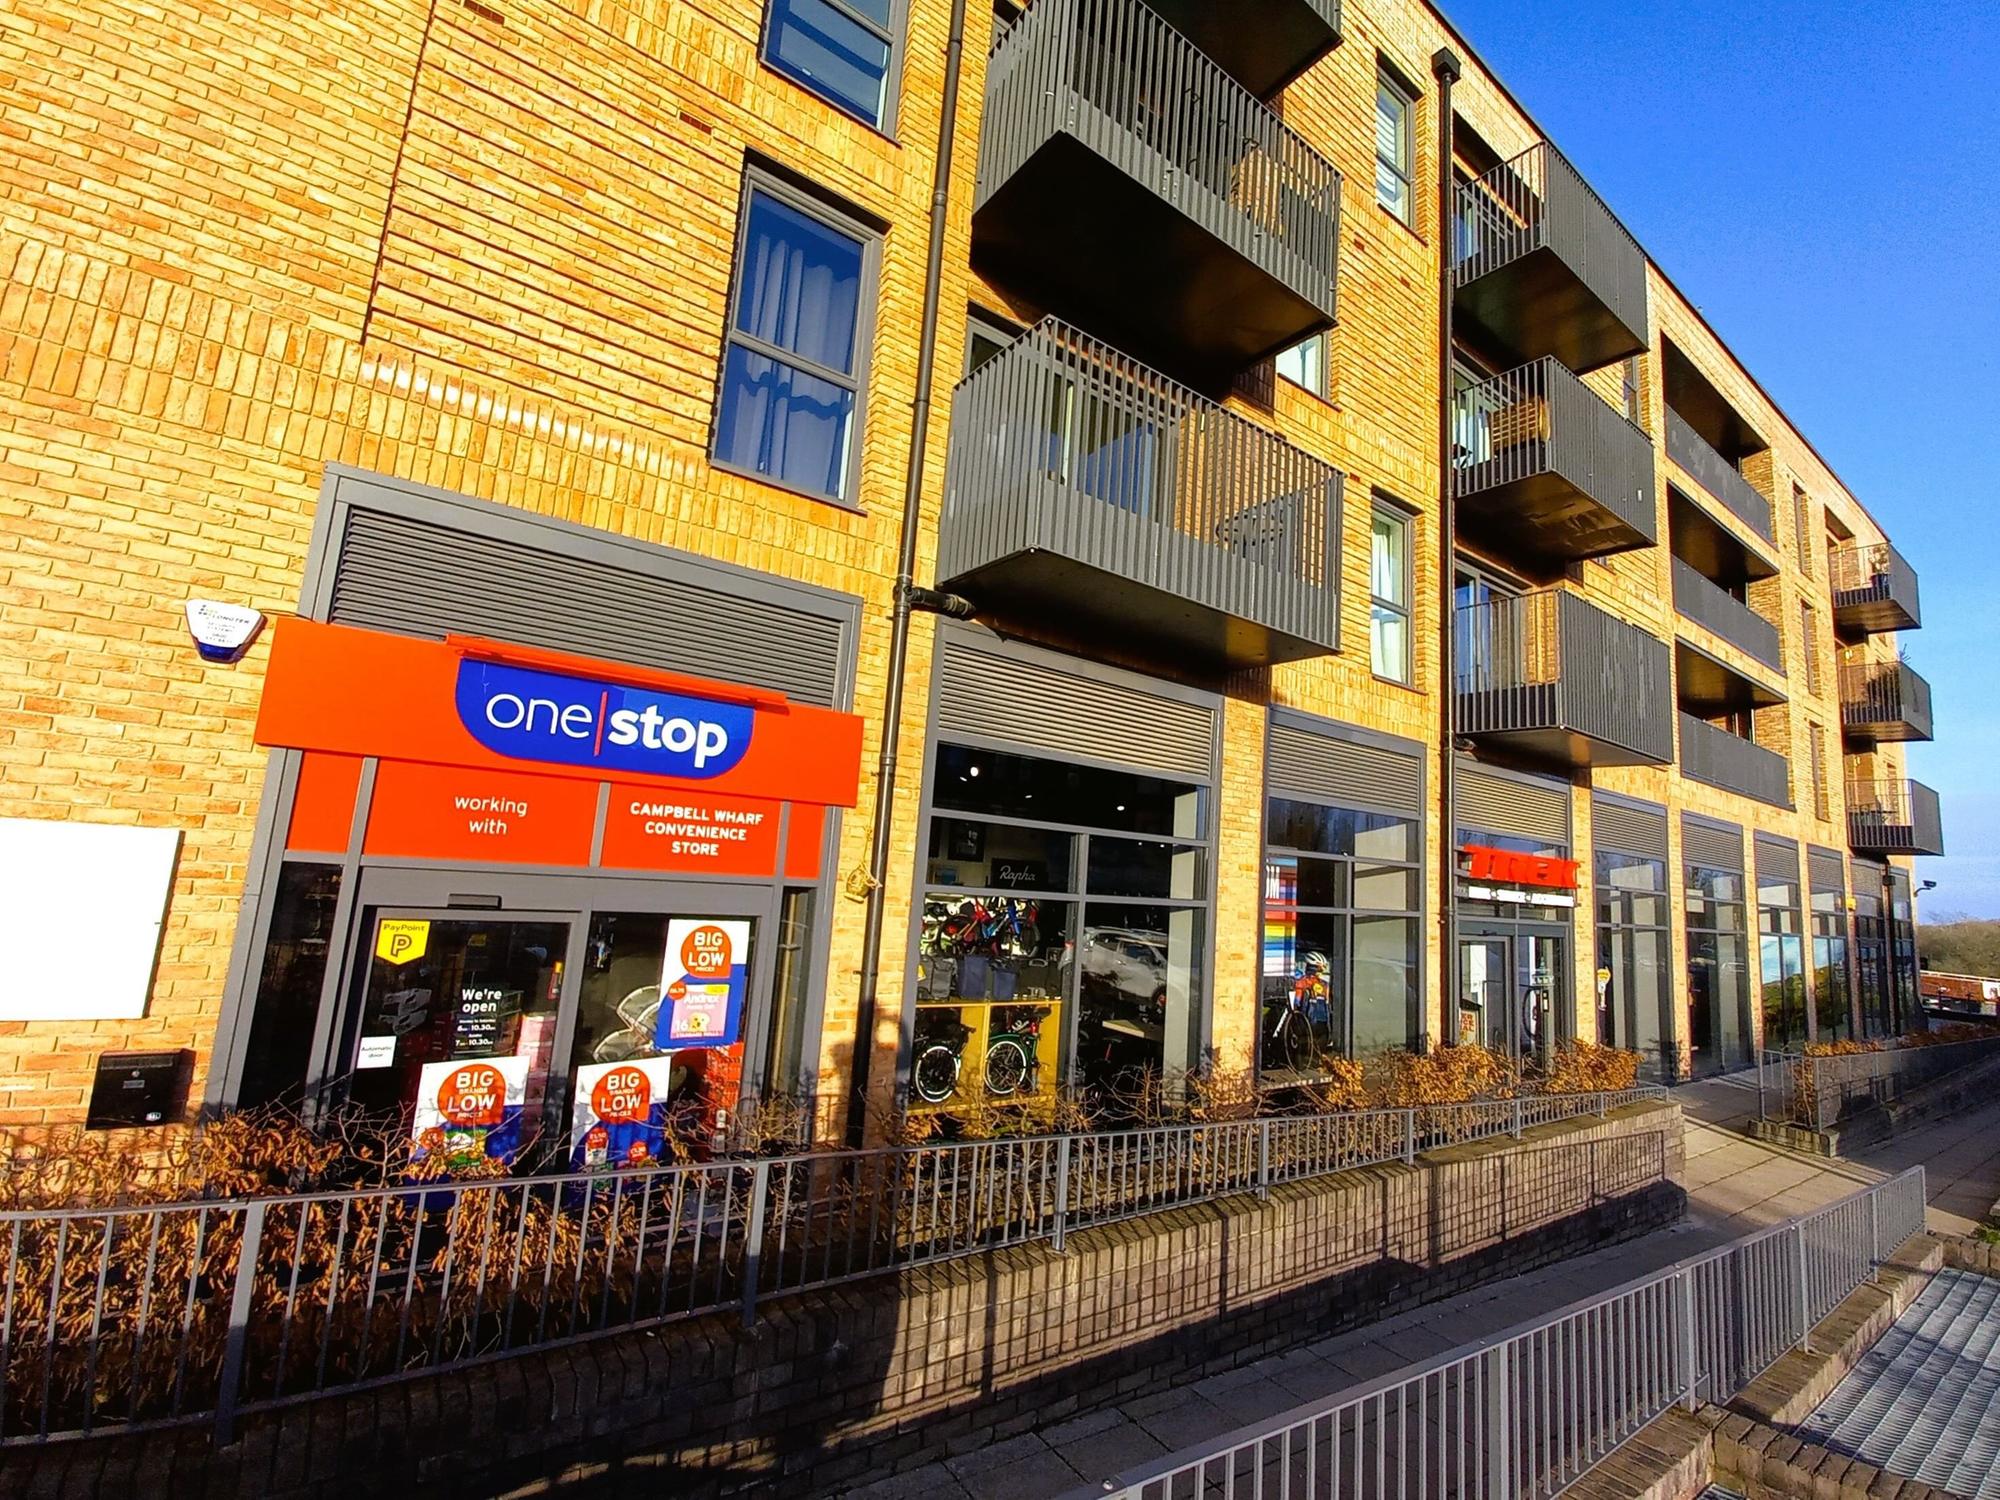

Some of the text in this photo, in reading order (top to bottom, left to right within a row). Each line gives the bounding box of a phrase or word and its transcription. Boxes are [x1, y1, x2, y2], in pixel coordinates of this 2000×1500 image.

[485, 693, 728, 769] one stop
[454, 796, 528, 817] working
[630, 801, 764, 825] CAMPBELL WHARF
[469, 818, 507, 835] with
[644, 821, 747, 841] CONVENIENCE
[671, 840, 719, 856] STORE
[999, 865, 1036, 887] Rapha
[383, 923, 426, 932] PayPoint
[390, 934, 412, 958] P
[694, 931, 723, 946] BIG
[687, 951, 725, 967] LOW
[462, 988, 503, 1001] We're
[462, 1002, 497, 1015] open
[456, 1070, 494, 1089] BIG
[606, 1072, 640, 1090] BIG
[447, 1094, 496, 1112] LOW
[600, 1093, 642, 1113] LOW
